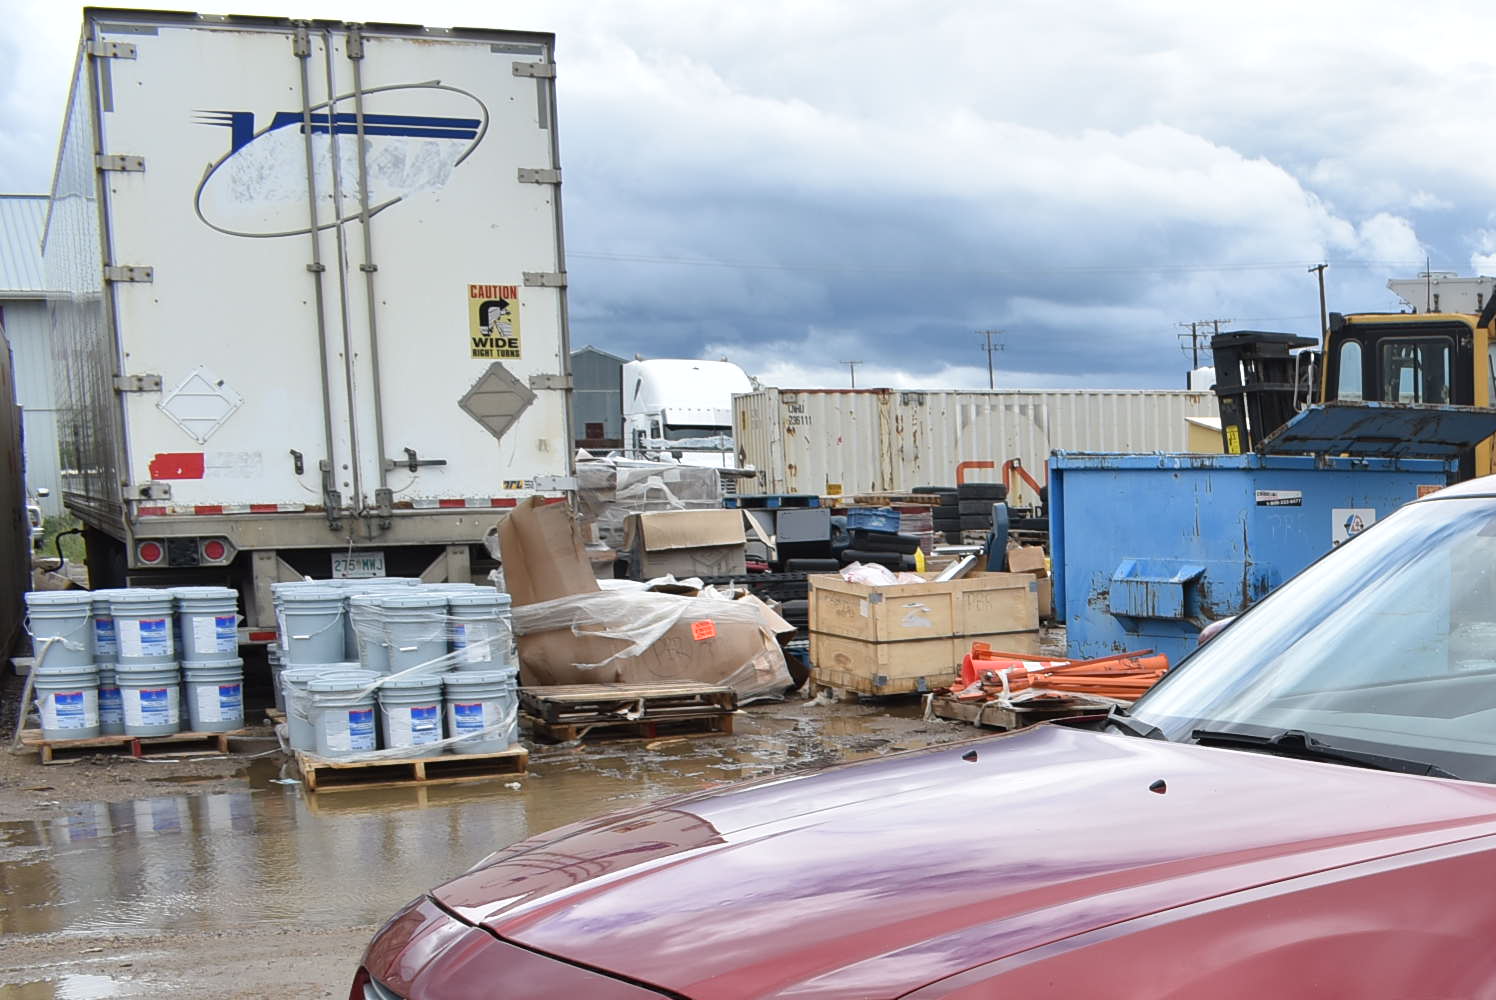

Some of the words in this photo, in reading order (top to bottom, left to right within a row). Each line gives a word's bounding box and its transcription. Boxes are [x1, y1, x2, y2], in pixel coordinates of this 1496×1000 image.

[470, 285, 518, 299] CAUTION
[472, 337, 519, 348] WIDE
[472, 348, 495, 358] RIGHT
[496, 349, 520, 358] TURNS
[335, 559, 356, 572] 275
